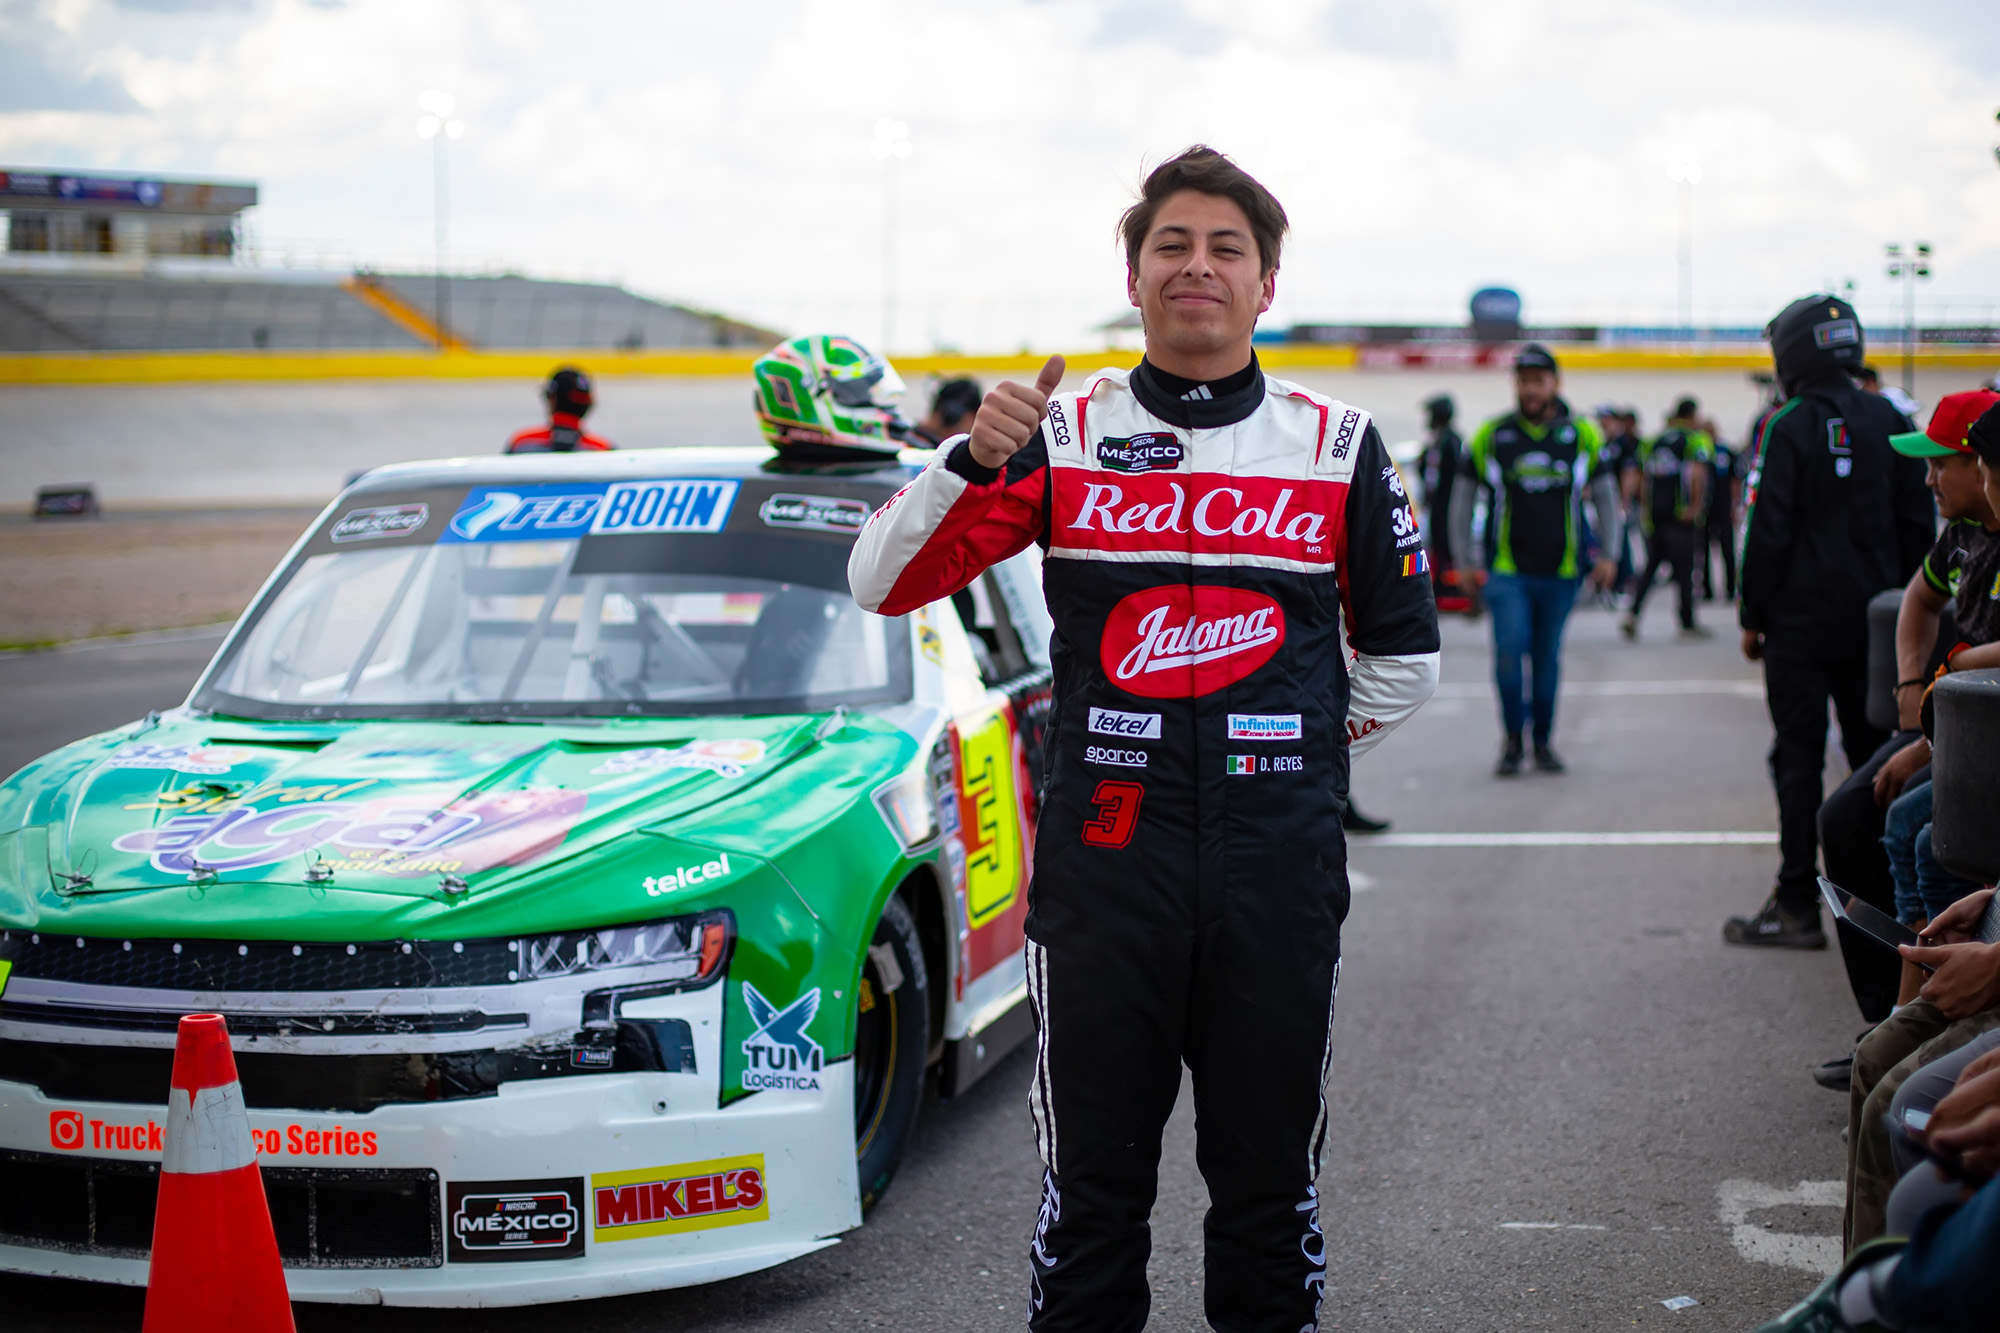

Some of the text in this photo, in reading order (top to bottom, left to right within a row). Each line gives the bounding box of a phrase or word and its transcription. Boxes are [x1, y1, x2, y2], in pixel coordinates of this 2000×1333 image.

[1048, 400, 1071, 446] sparco
[1331, 409, 1358, 459] sparco
[1100, 446, 1180, 461] MÉXICO
[1131, 437, 1156, 448] NASCAR
[601, 486, 723, 527] BOHN
[1067, 482, 1327, 543] Red Cola
[1306, 545, 1322, 554] MR
[1116, 605, 1277, 680] Jaloma
[1094, 712, 1153, 735] telcel
[1085, 745, 1148, 764] sparco
[1260, 755, 1303, 772] D. REYES
[1081, 780, 1144, 850] 3
[642, 853, 731, 896] telcel
[745, 1044, 820, 1072] TUM
[744, 1072, 820, 1090] LOGÍSTICA
[89, 1120, 165, 1151] Truck
[287, 1125, 377, 1156] Series
[505, 1202, 537, 1211] NASCAR
[460, 1213, 572, 1231] MÉXICO
